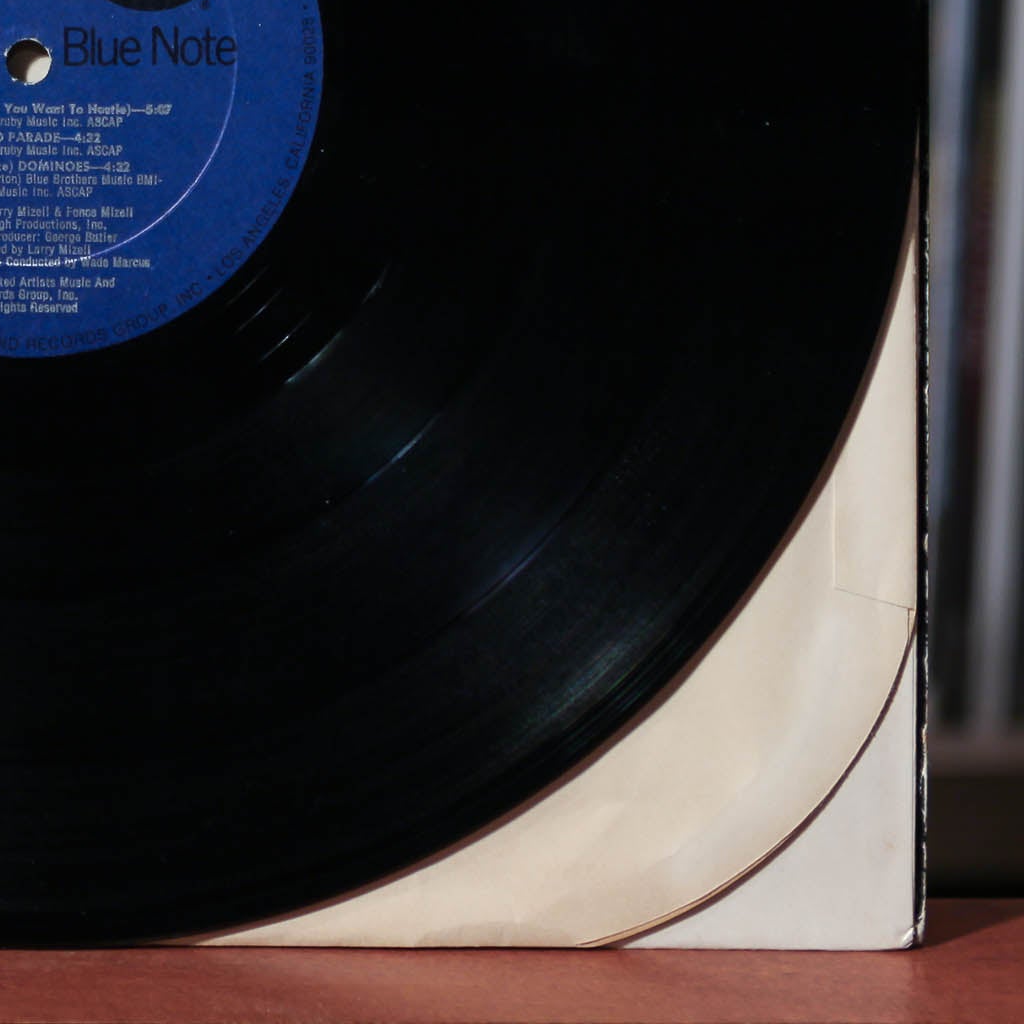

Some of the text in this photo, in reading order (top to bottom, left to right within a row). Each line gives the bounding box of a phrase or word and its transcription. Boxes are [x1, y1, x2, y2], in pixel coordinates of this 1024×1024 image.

[64, 26, 237, 66] Blue Note
[5, 104, 28, 114] You
[32, 103, 64, 114] Want
[69, 104, 83, 114] To
[27, 117, 58, 127] Music
[63, 117, 82, 127] Inc.
[87, 117, 123, 127] ASCAP
[27, 145, 58, 155] Music
[63, 146, 82, 156] Inc.
[87, 145, 123, 156] ASCAP
[26, 174, 49, 184] Blue
[53, 174, 97, 184] Brothers
[102, 175, 133, 184] Music
[210, 244, 243, 277] LOS
[282, 71, 317, 171] CALIFORNIA
[57, 187, 93, 197] ASCAP
[17, 206, 49, 217] Mizell
[54, 207, 61, 217] &
[101, 206, 133, 218] Mizell
[16, 219, 81, 231] Productions,
[87, 220, 107, 230] Inc.
[45, 232, 81, 244] George
[85, 232, 116, 242] Butler
[11, 244, 24, 256] by
[28, 244, 55, 256] Larry
[59, 245, 91, 254] Mizell
[6, 257, 60, 266] Conducted
[65, 258, 77, 269] by
[80, 256, 108, 267] Wade
[113, 257, 150, 268] Marcus
[19, 276, 55, 288] Artists
[60, 277, 91, 288] Music
[94, 277, 116, 288] And
[58, 290, 78, 300] Inc.
[30, 302, 78, 312] Reserved
[25, 325, 107, 349] RECORDS
